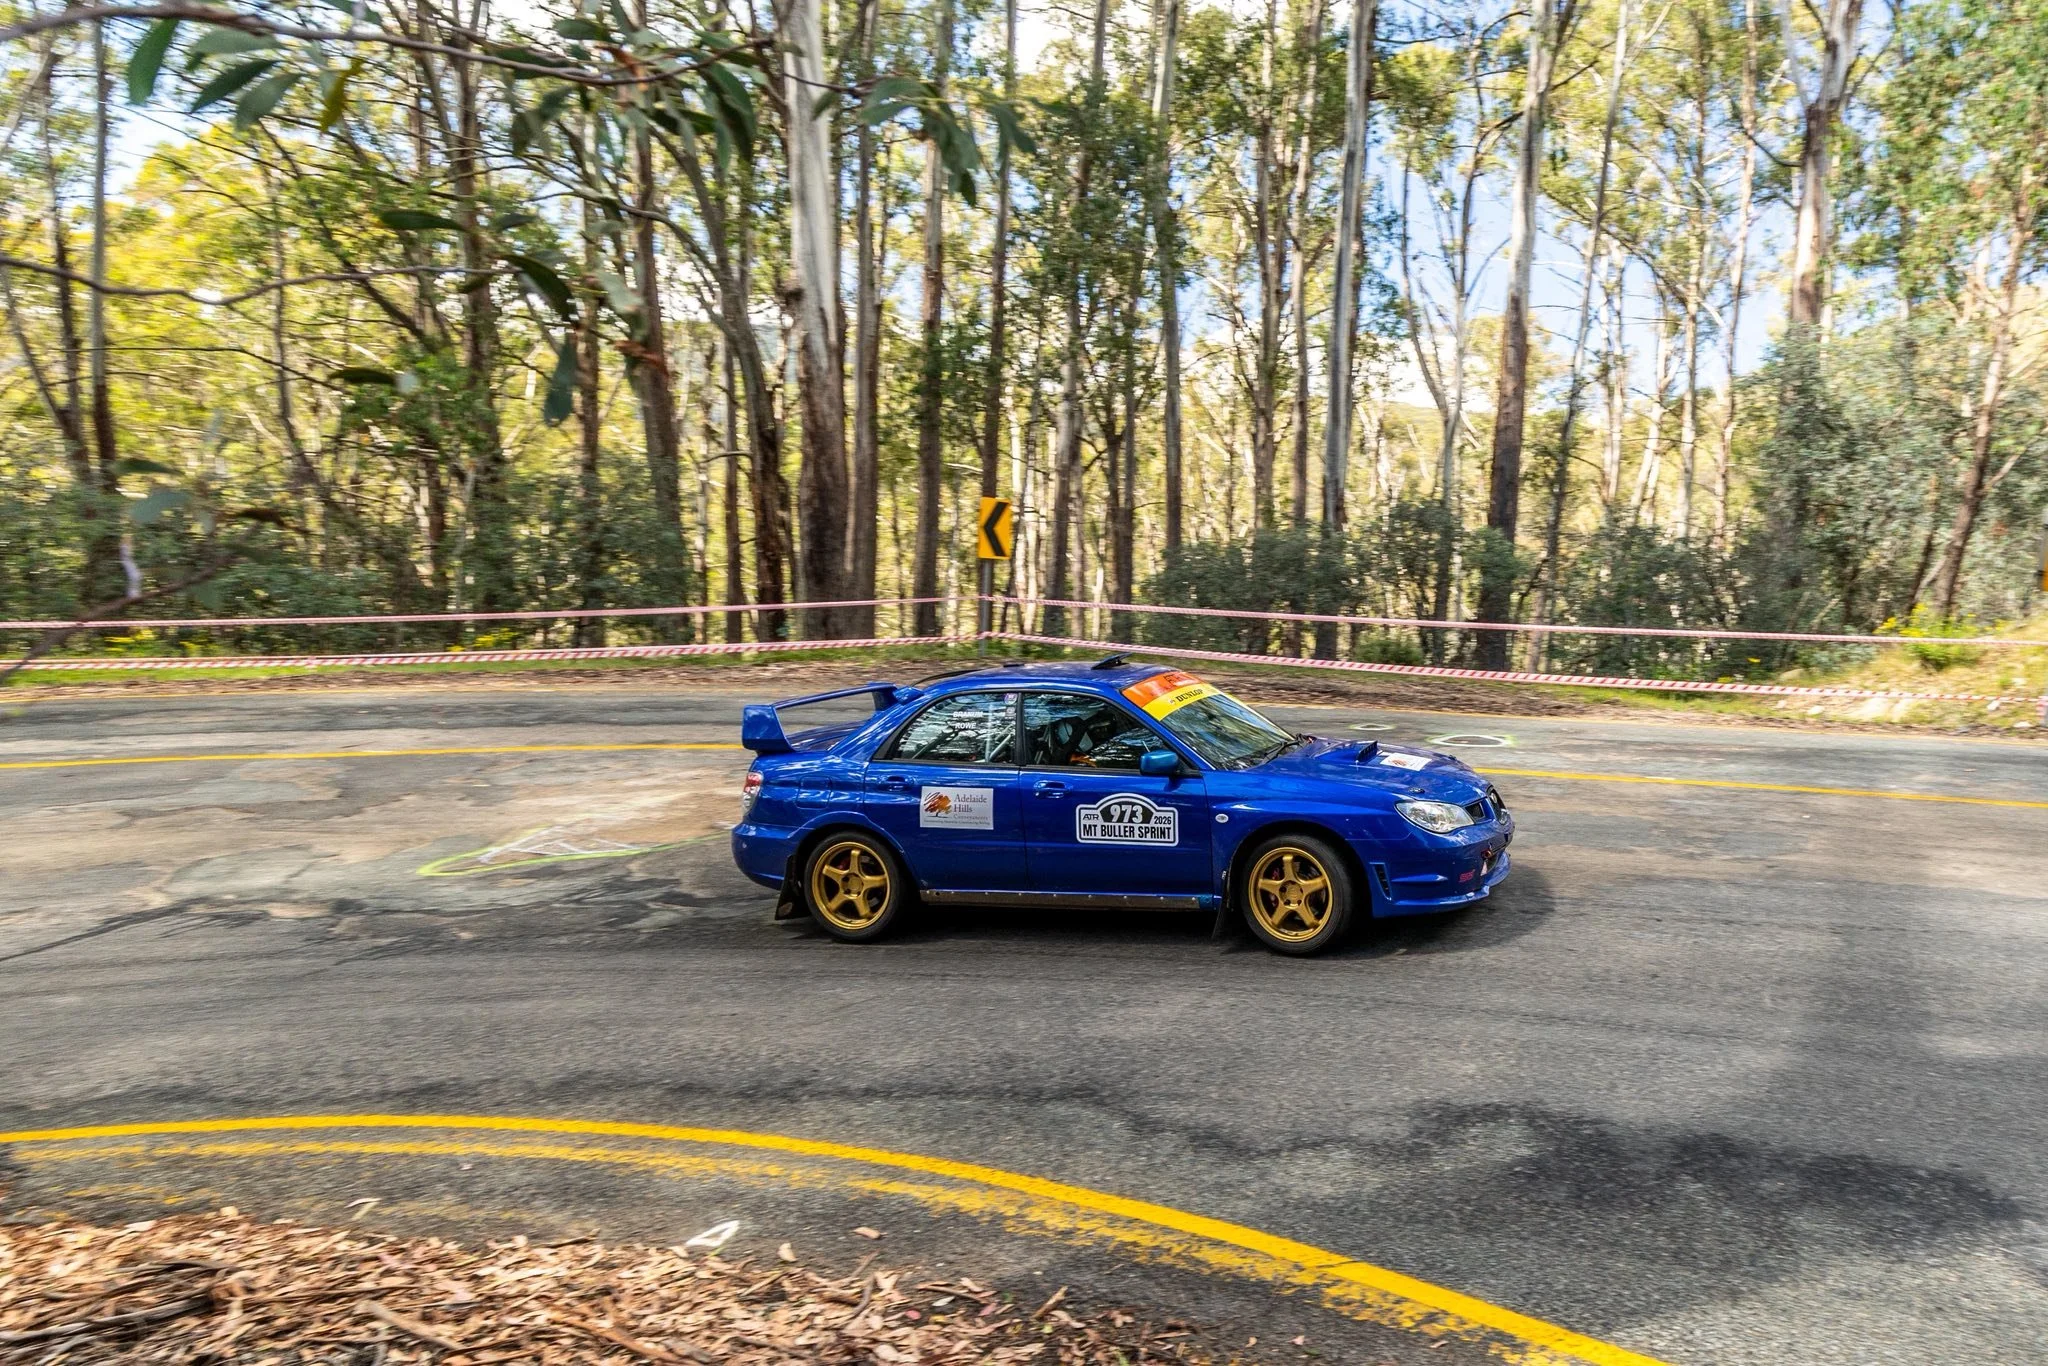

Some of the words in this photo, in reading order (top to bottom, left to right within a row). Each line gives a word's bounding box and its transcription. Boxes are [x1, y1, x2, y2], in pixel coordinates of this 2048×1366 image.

[1175, 688, 1204, 702] DUNLOP
[954, 793, 987, 803] Adelaide
[954, 804, 973, 813] Hills
[1110, 804, 1143, 824] 973
[1154, 815, 1172, 825] 2026
[1083, 824, 1098, 837] MT
[1101, 825, 1135, 838] BULLER
[1138, 826, 1172, 839] SPRINT
